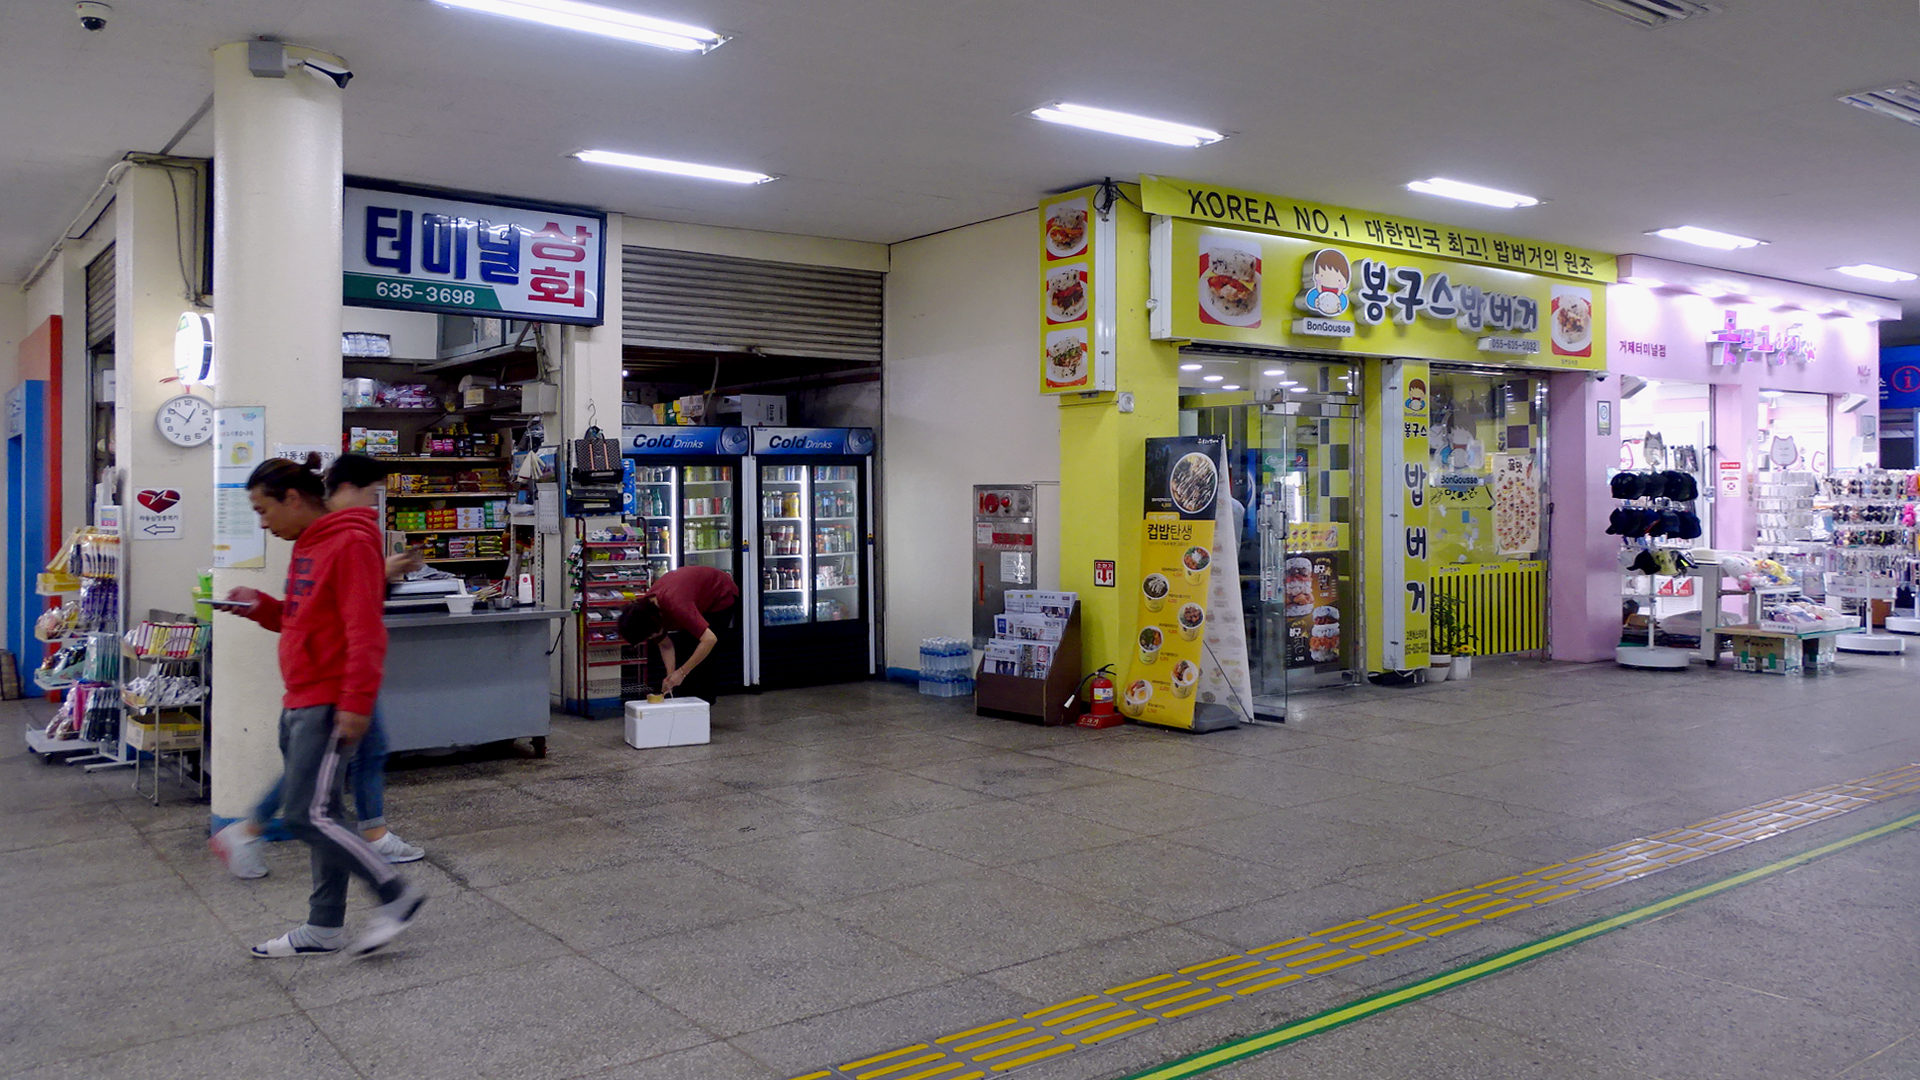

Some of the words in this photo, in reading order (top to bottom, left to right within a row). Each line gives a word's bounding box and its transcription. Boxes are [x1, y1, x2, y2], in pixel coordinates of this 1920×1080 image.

[1187, 189, 1280, 227] KOREA
[1293, 205, 1350, 237] NO.1
[1364, 219, 1441, 252] 대한민국
[1447, 232, 1489, 260] 최고!
[1493, 239, 1559, 271] 밥버거의
[1563, 250, 1594, 276] 원조
[365, 205, 521, 285] 터미널
[527, 221, 593, 308] 상회
[376, 281, 475, 305] 635-3698
[1306, 320, 1351, 333] BonGousse
[1491, 338, 1537, 351] 055-635-5032
[1619, 340, 1666, 357] 거제터미널점
[1404, 422, 1427, 438] 봉구스
[633, 433, 676, 449] Cold
[673, 439, 704, 449] Drinks
[769, 434, 806, 449] Cold
[805, 440, 833, 450] Drinks
[279, 450, 336, 460] 자동심격기
[1147, 523, 1193, 540] 컵밥탄생
